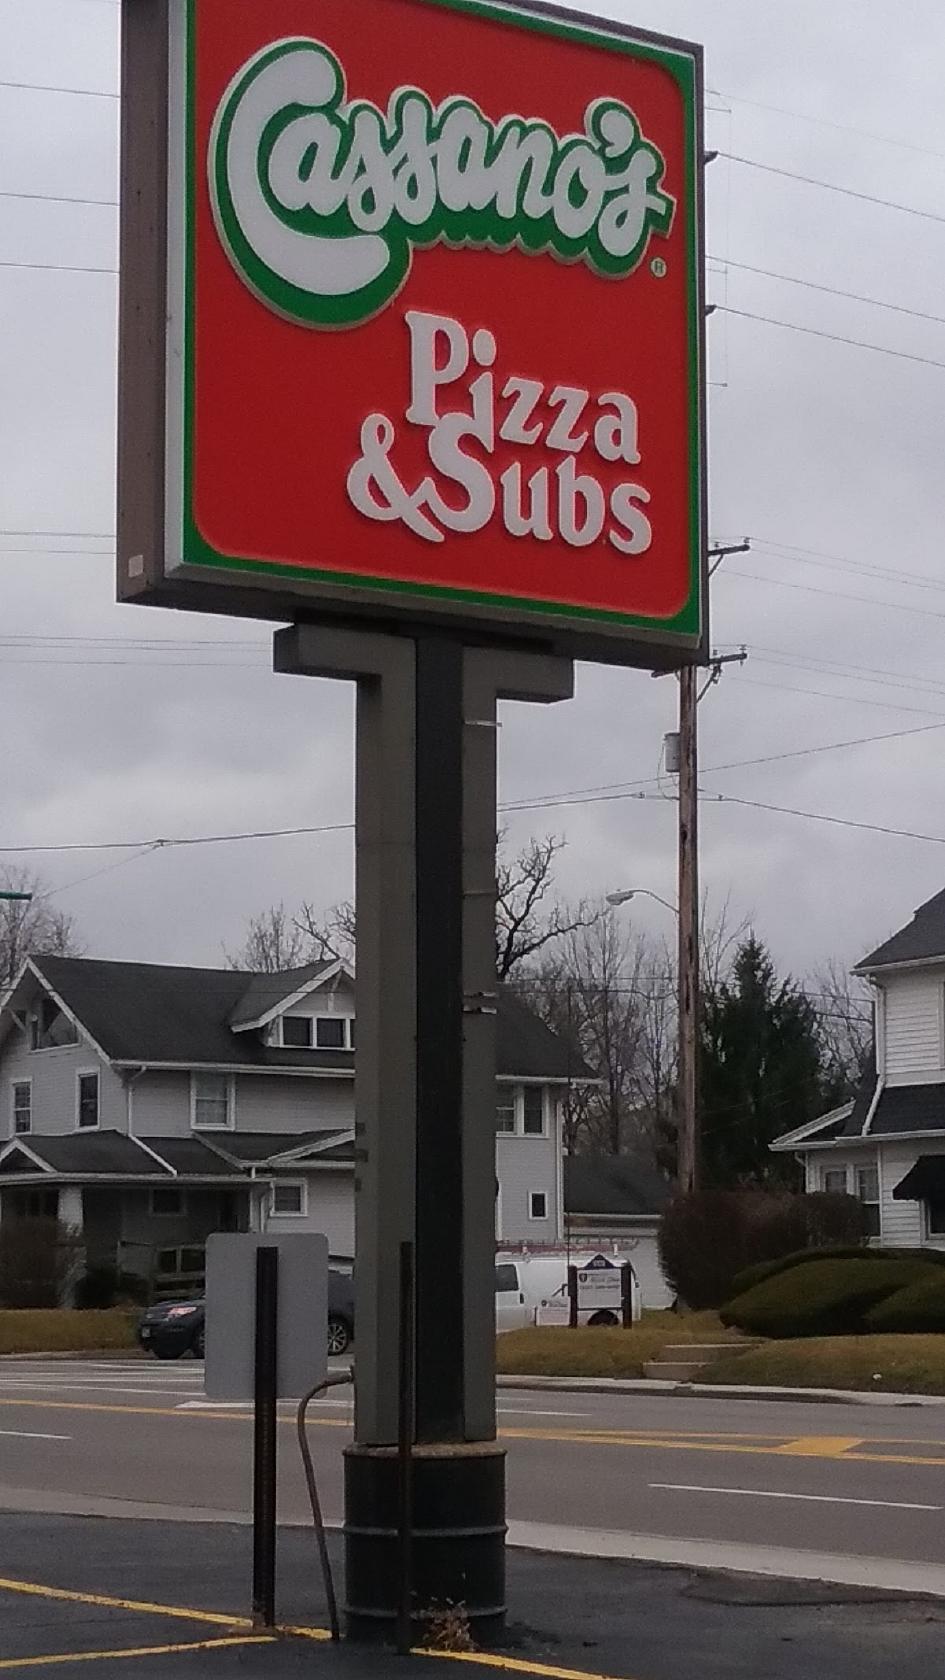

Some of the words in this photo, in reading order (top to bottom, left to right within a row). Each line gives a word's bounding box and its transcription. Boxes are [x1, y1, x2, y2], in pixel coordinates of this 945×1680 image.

[227, 49, 668, 297] Cassano's
[405, 310, 642, 465] Pizza
[347, 412, 445, 543] &
[428, 412, 652, 555] Subs
